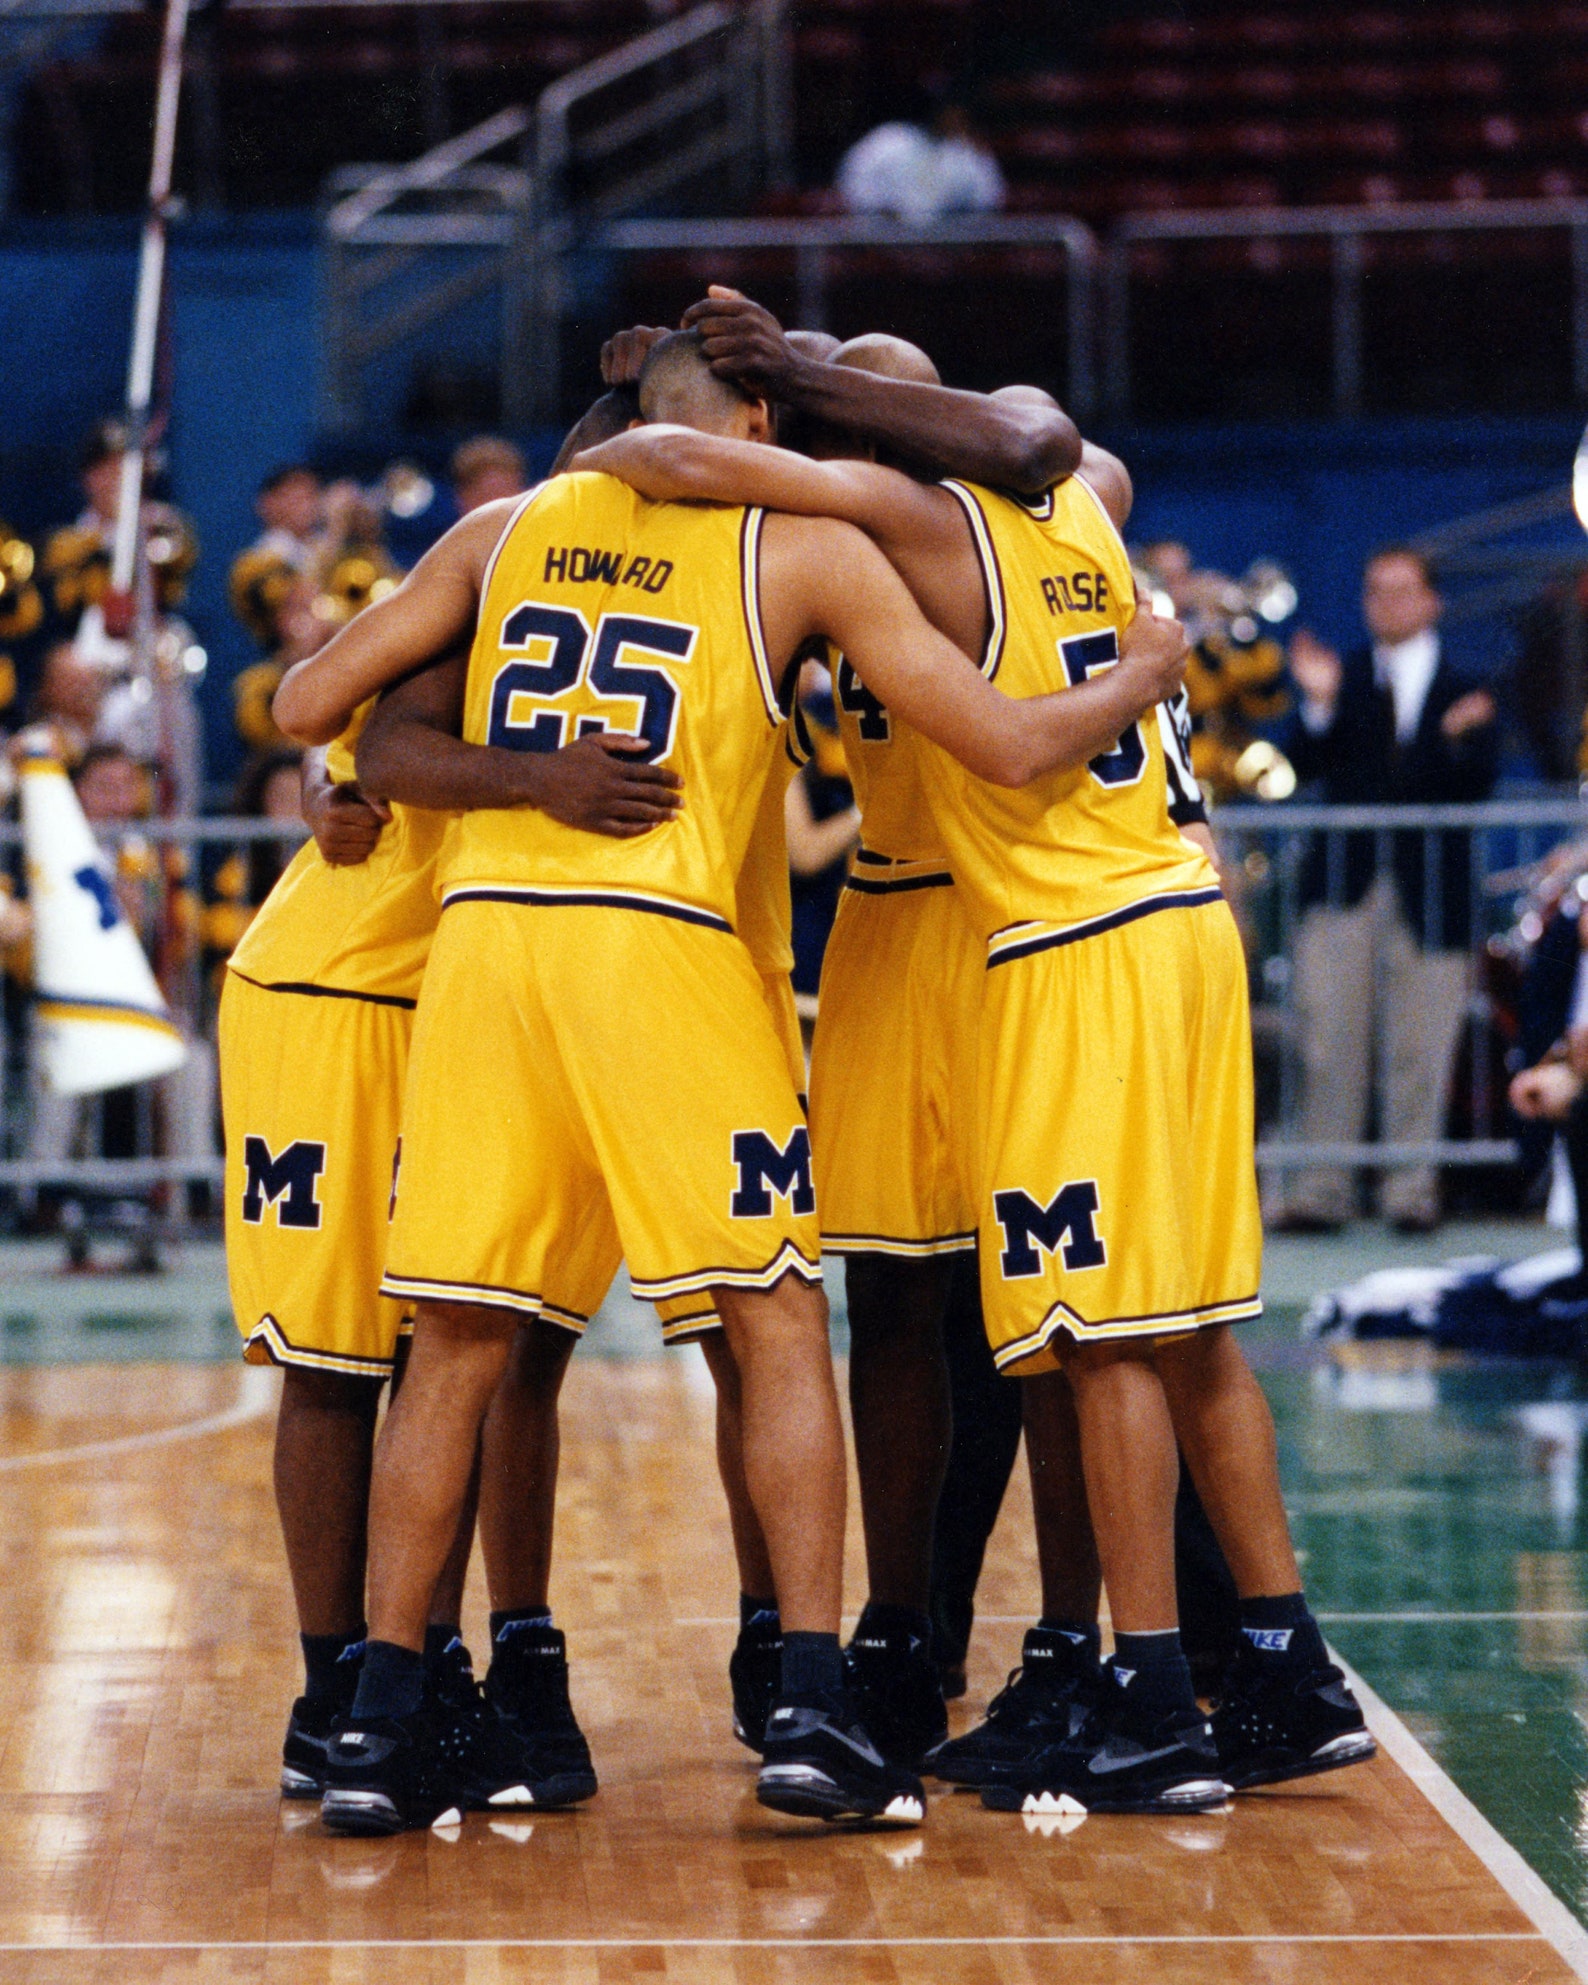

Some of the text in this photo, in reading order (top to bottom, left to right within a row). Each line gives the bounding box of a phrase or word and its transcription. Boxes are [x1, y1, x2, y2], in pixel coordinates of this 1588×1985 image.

[543, 546, 674, 594] HOWRD
[486, 599, 700, 766] 25
[242, 1132, 327, 1230] M
[729, 1124, 817, 1219] M
[992, 1177, 1108, 1280] M
